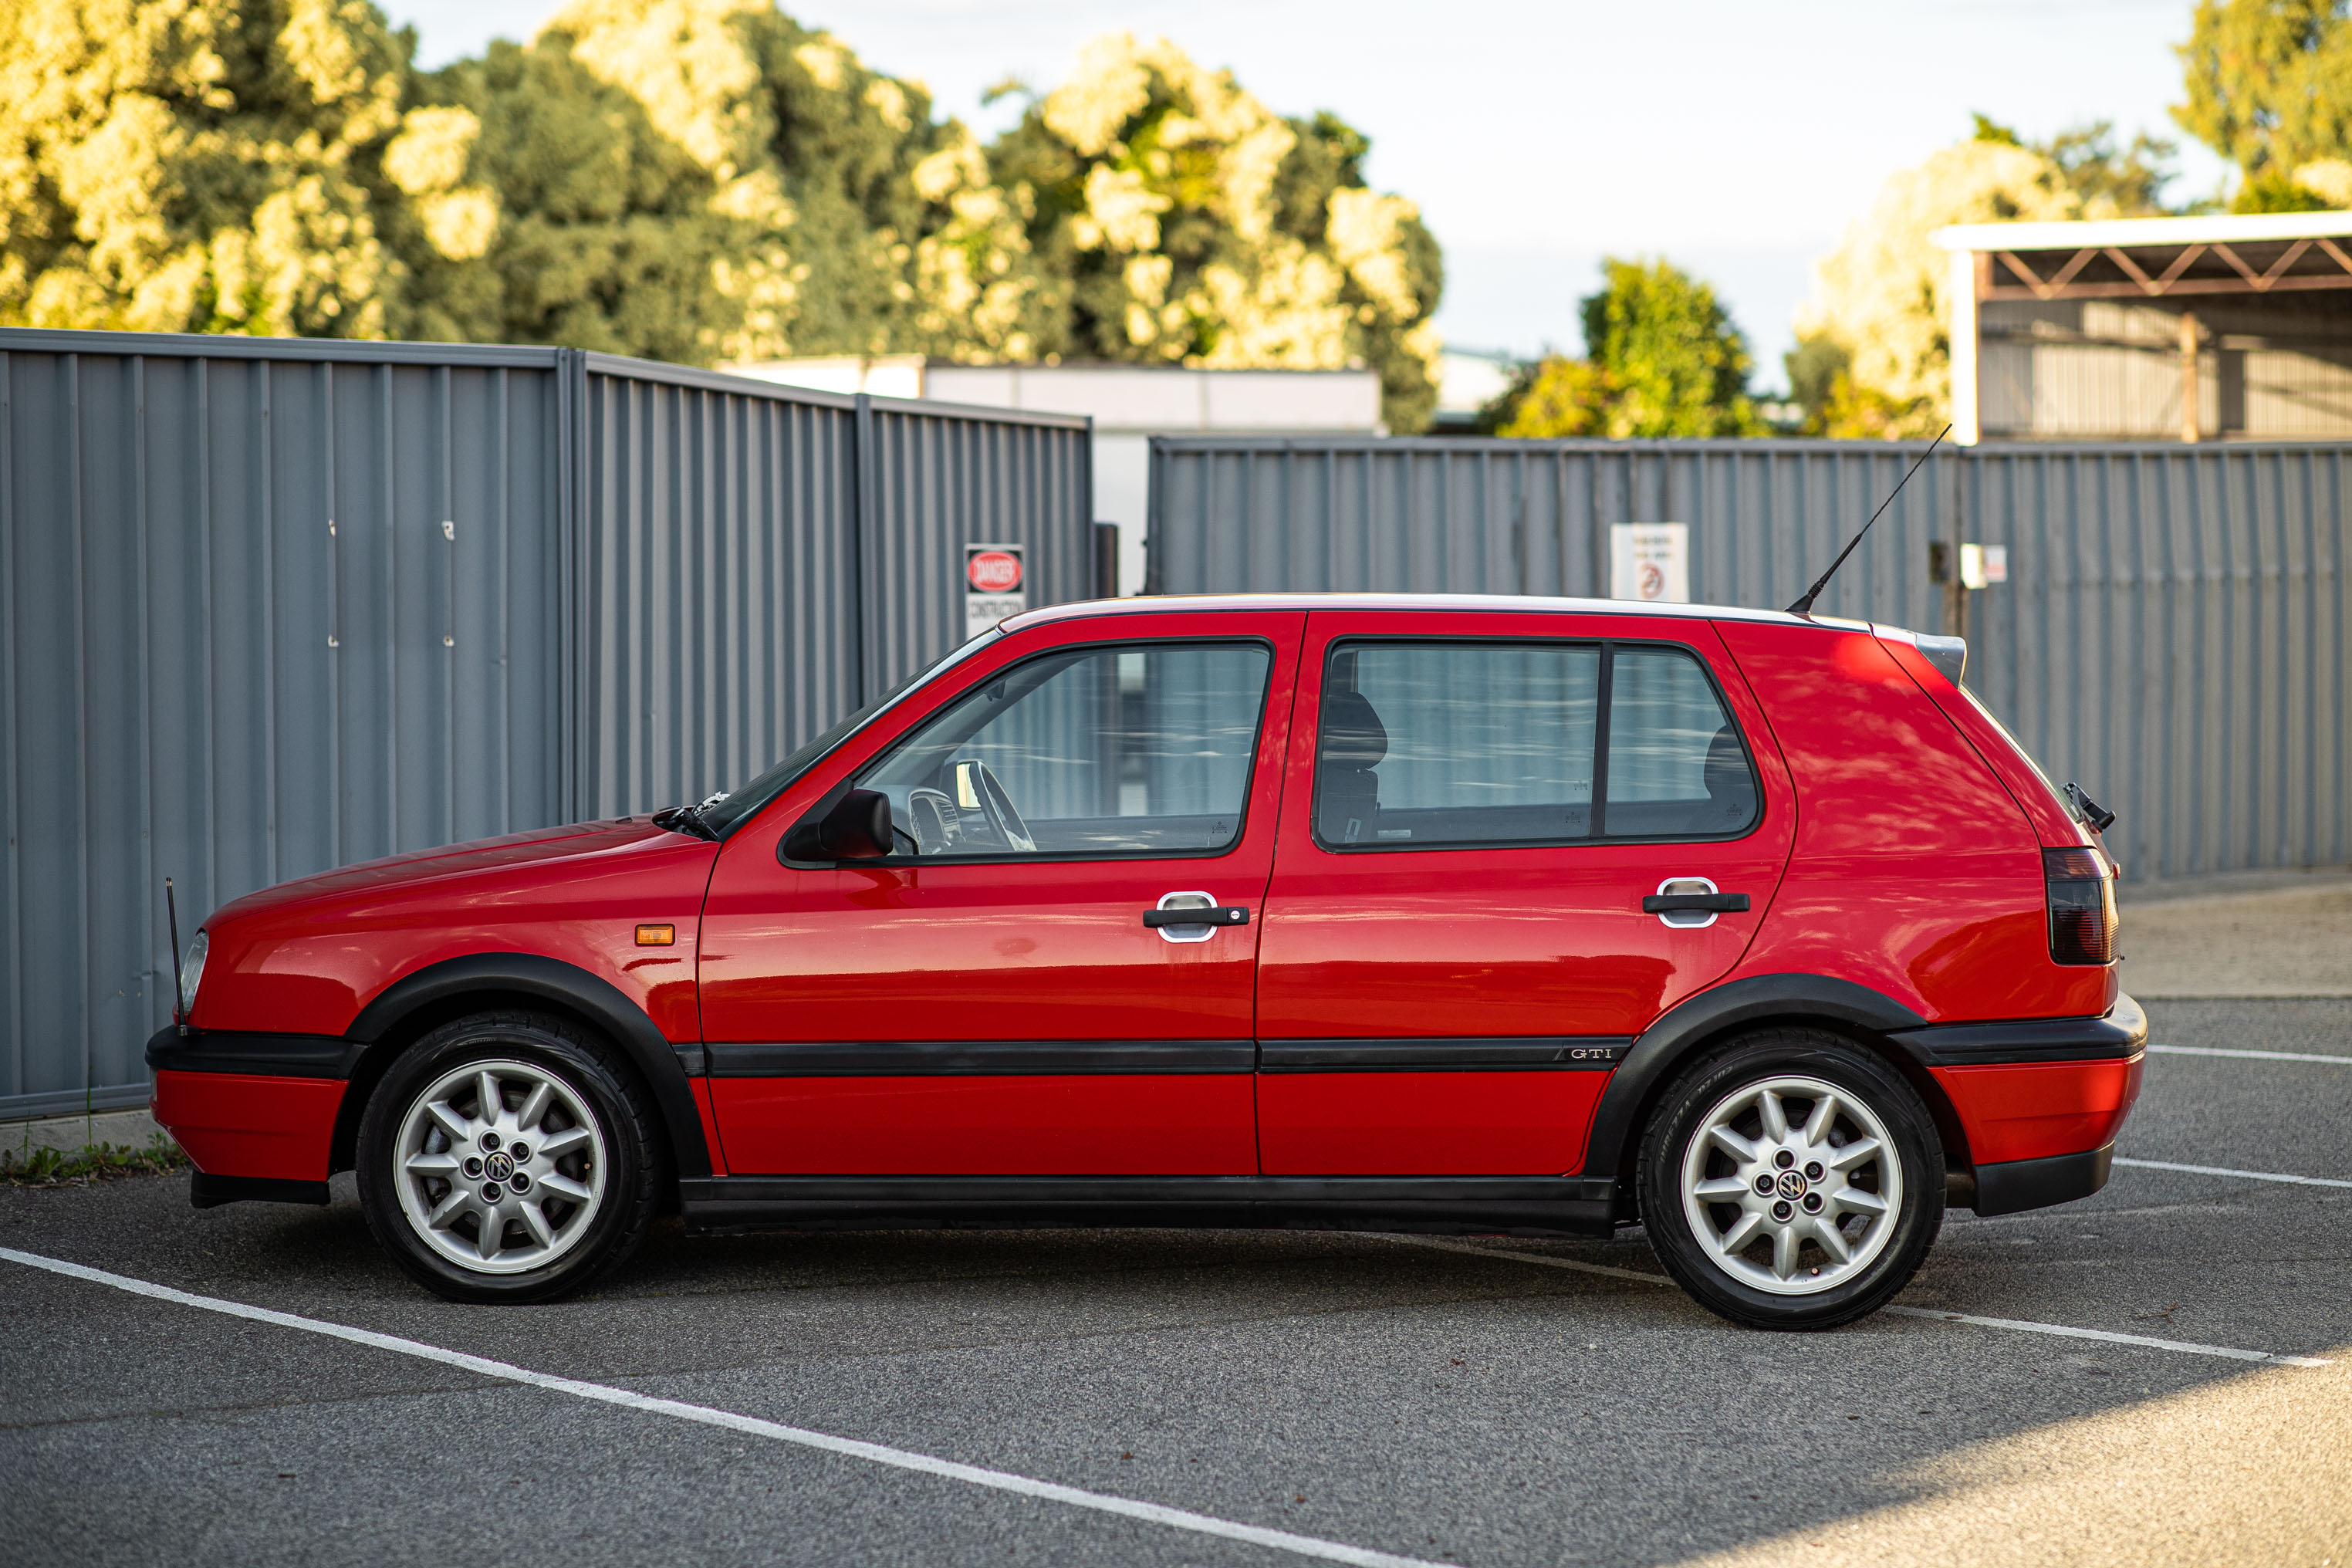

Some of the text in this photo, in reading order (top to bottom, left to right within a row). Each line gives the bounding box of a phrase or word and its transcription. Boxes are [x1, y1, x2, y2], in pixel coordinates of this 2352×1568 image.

[975, 559, 1014, 583] DANGER
[1571, 1049, 1611, 1059] GTI
[1660, 1100, 1691, 1164] DIREZZA
[1778, 1172, 1806, 1199] VW
